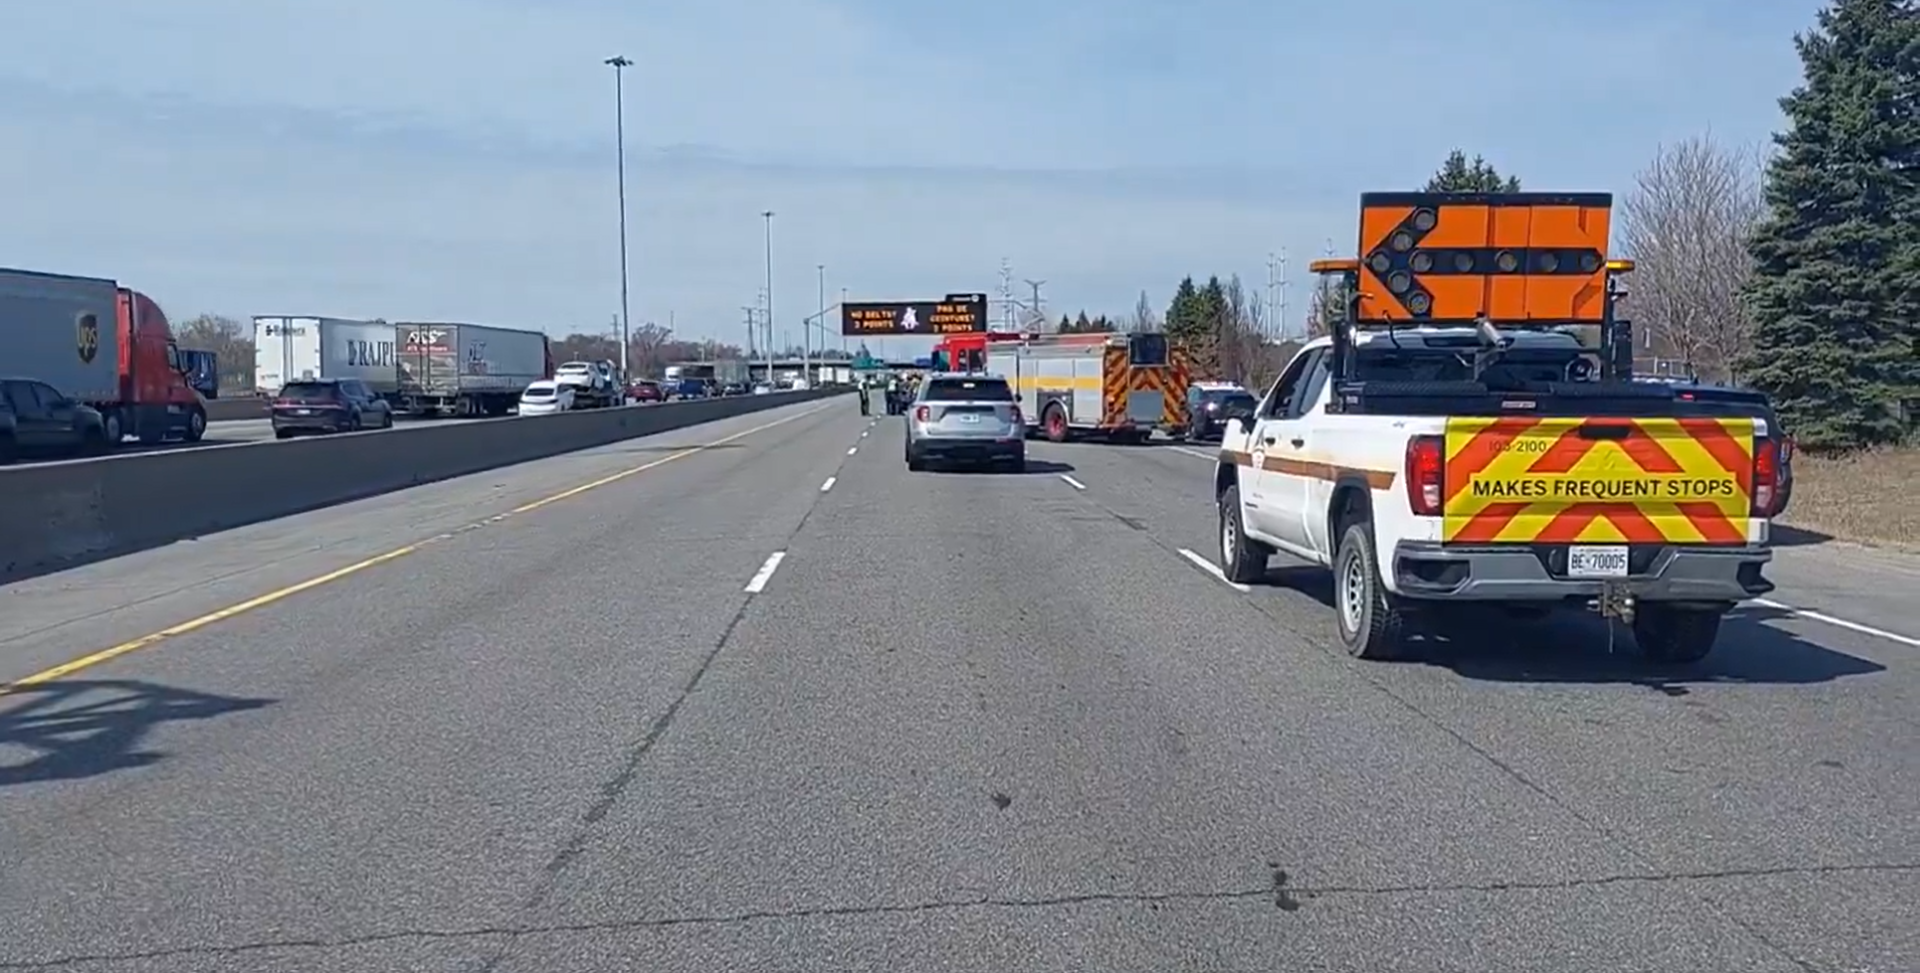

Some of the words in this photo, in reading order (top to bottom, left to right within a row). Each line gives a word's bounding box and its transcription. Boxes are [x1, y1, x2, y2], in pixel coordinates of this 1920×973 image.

[863, 319, 894, 328] POINTS
[942, 323, 973, 332] POINTS
[1472, 480, 1547, 496] MAKES
[1553, 479, 1662, 499] FREQUENT
[1667, 479, 1734, 496] STOPS
